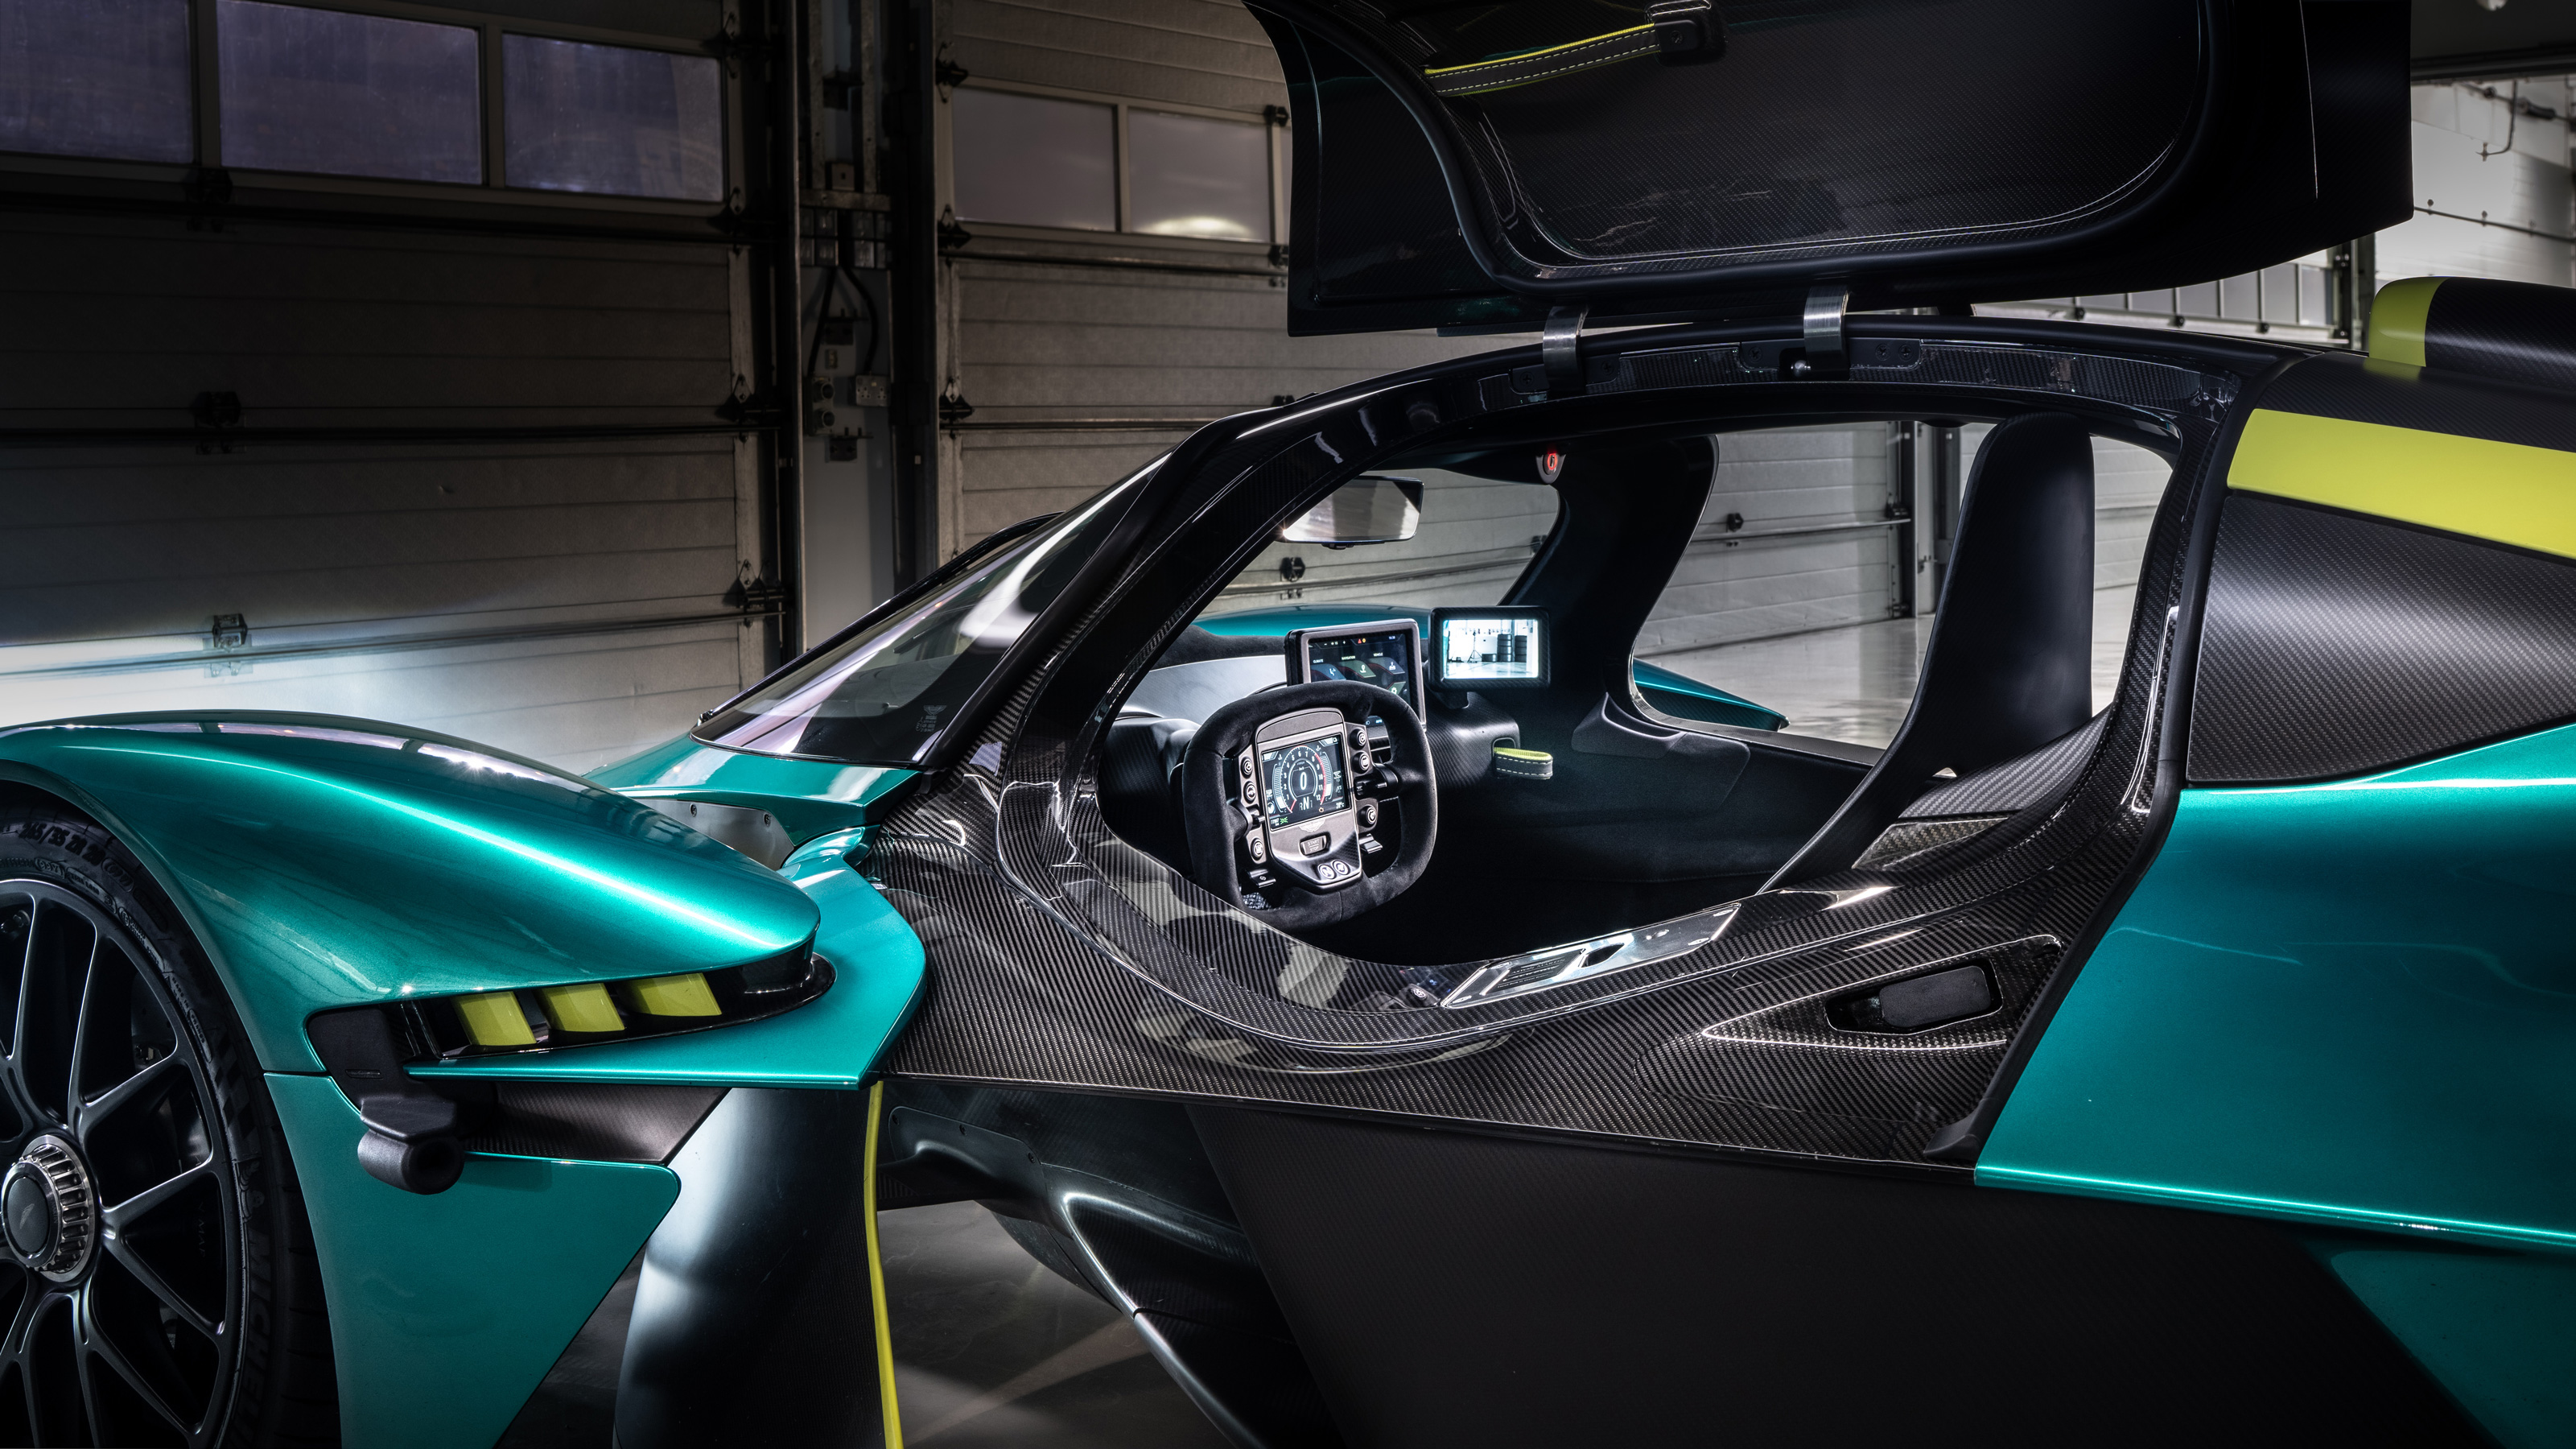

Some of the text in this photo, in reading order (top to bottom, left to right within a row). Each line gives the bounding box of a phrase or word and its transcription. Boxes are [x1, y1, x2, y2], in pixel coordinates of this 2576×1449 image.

[1300, 771, 1308, 791] 0
[1307, 838, 1320, 846] START
[82, 844, 106, 866] 20
